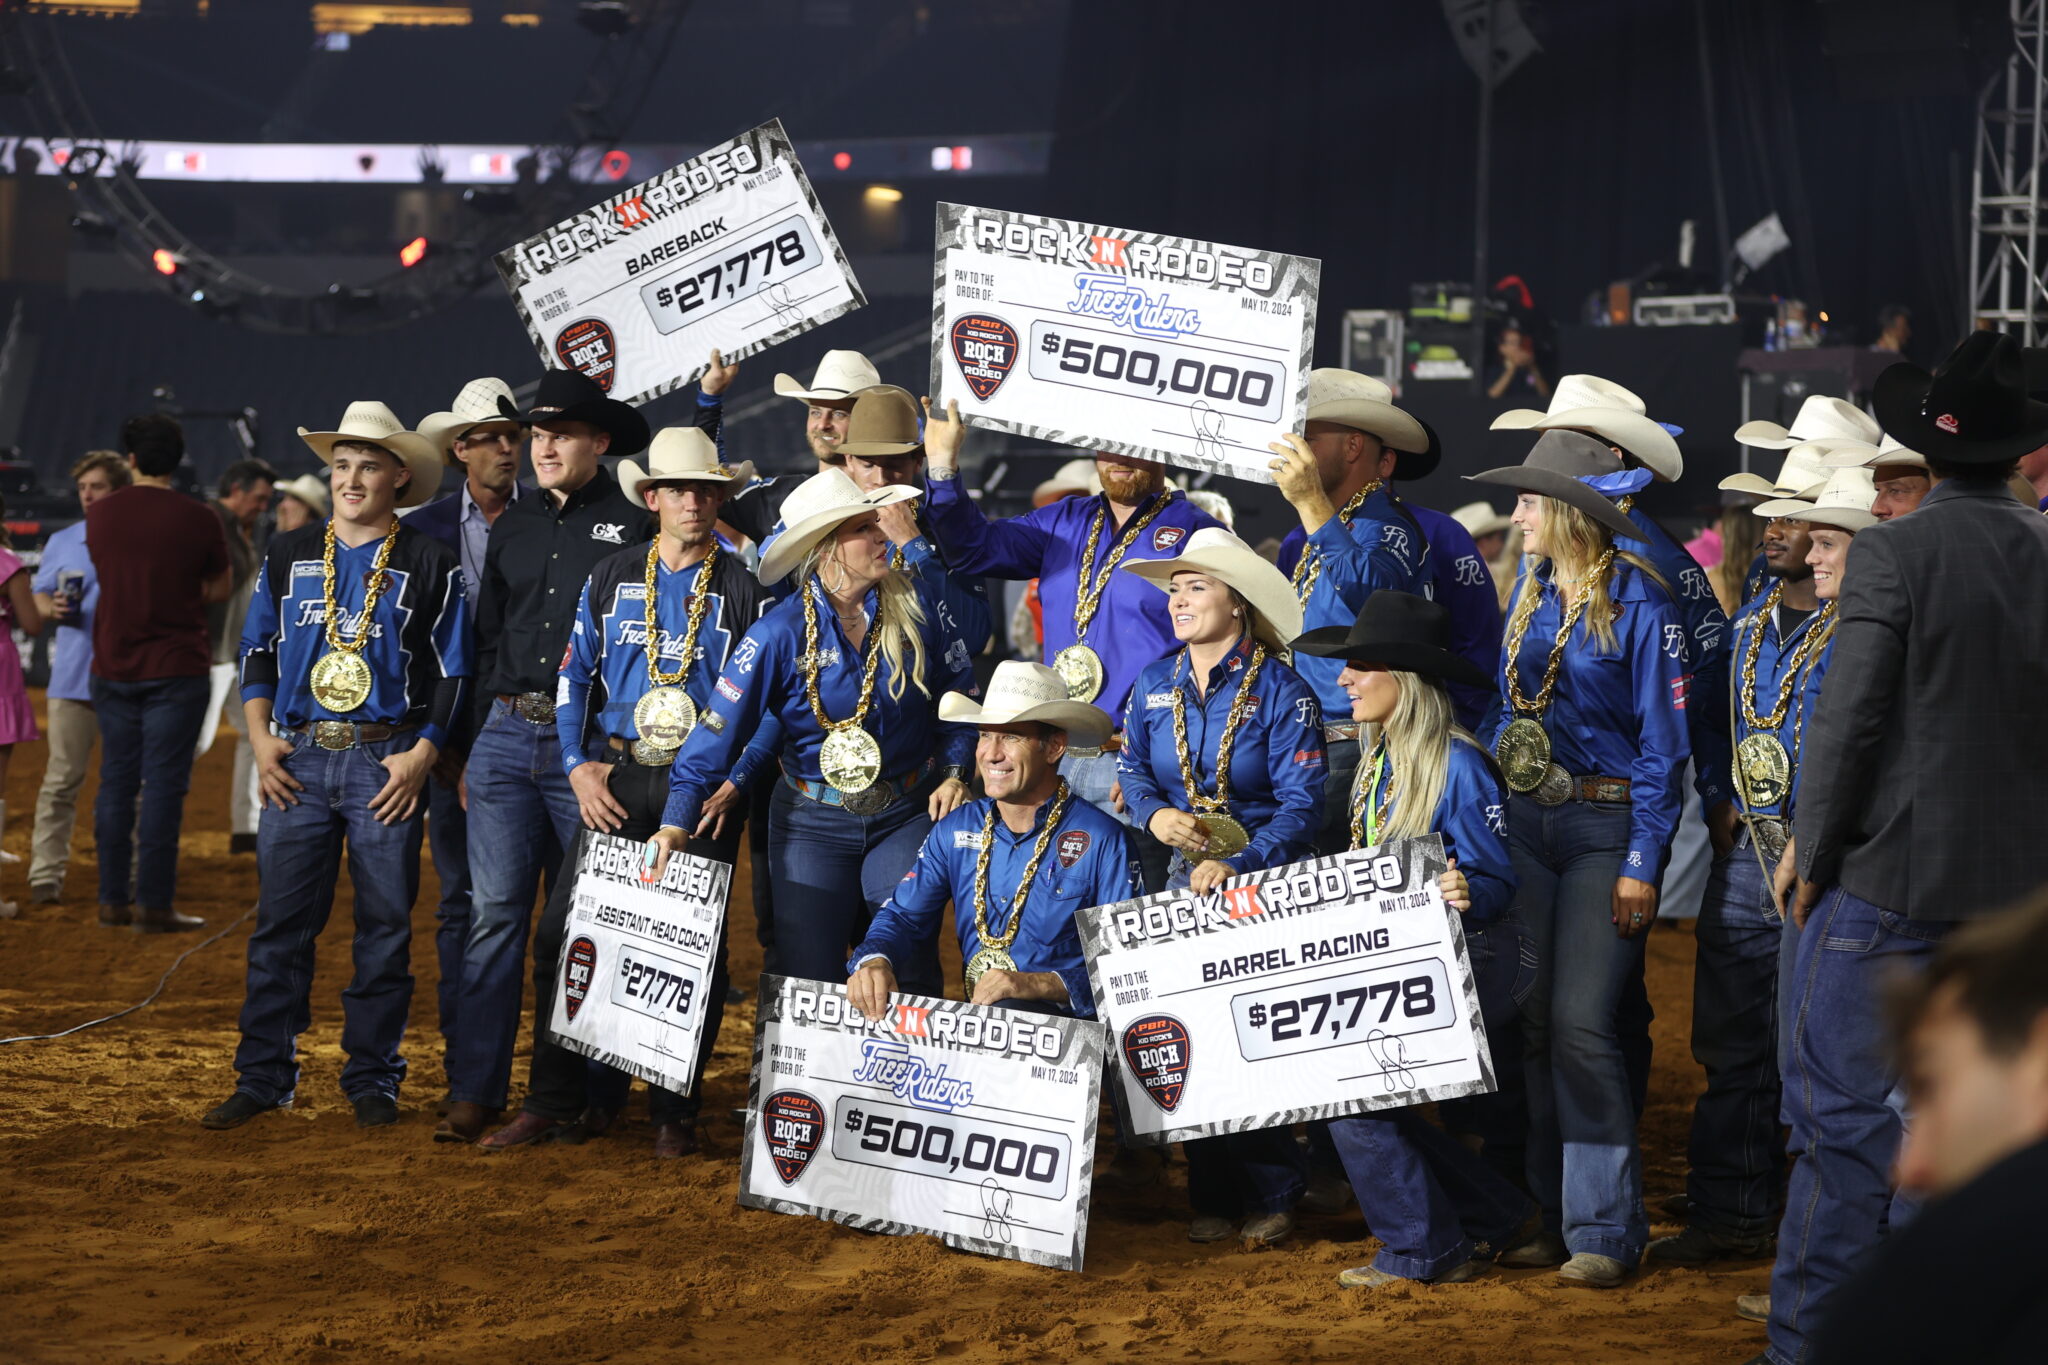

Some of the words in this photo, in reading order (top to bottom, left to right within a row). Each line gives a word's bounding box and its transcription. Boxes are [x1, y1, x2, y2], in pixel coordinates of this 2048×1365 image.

[529, 211, 620, 271] ROCK
[623, 204, 641, 223] N
[645, 144, 758, 215] RODEO
[625, 217, 727, 276] BAREBACK
[977, 218, 1089, 263] ROCK
[1101, 241, 1117, 262] N
[1132, 242, 1274, 292] RODEO
[656, 229, 806, 314] $27,778
[955, 269, 968, 282] PAY
[970, 271, 979, 284] TO
[981, 273, 994, 286] THE
[956, 285, 980, 300] ORDER
[1242, 297, 1258, 310] MAY
[1260, 300, 1269, 314] 17,
[1271, 301, 1292, 316] 2024
[970, 318, 1001, 329] PBR
[570, 339, 608, 367] ROCK
[964, 341, 1005, 364] ROCK
[964, 365, 1002, 380] RODEO
[1041, 331, 1274, 407] $500,000
[594, 843, 643, 883] ROCK
[660, 861, 712, 899] ODEO
[1116, 892, 1226, 943] ROCK
[1234, 890, 1252, 914] N
[1263, 854, 1404, 914] RODEO
[1379, 898, 1396, 914] MAY
[1397, 896, 1410, 911] 17,
[1409, 891, 1431, 908] 2024
[595, 904, 651, 935] ASSISTANT
[649, 921, 678, 943] HEAD
[677, 926, 712, 954] COACH
[1202, 947, 1296, 984] BARREL
[1300, 927, 1390, 965] RACING
[620, 956, 695, 1016] $27,778
[1109, 975, 1123, 989] PAY
[1123, 973, 1134, 987] TO
[1134, 970, 1149, 984] THE
[1115, 991, 1140, 1006] ORDER
[1249, 974, 1437, 1043] $27,778
[904, 1009, 919, 1033] N
[932, 1009, 1062, 1060] RODEO
[1138, 1020, 1167, 1032] PBR
[770, 1043, 782, 1057] PAY
[784, 1046, 793, 1059] TO
[794, 1047, 806, 1061] THE
[1138, 1037, 1149, 1045] KID
[771, 1060, 794, 1076] ORDER
[1138, 1044, 1180, 1070] ROCK
[1031, 1065, 1046, 1079] MAY
[1048, 1068, 1057, 1083] 17,
[1059, 1069, 1078, 1085] 2024
[1145, 1072, 1182, 1088] RODEO
[781, 1096, 810, 1107] PBR
[774, 1119, 812, 1143] ROCK
[773, 1146, 808, 1161] RODEO
[845, 1108, 1060, 1183] $500,000
